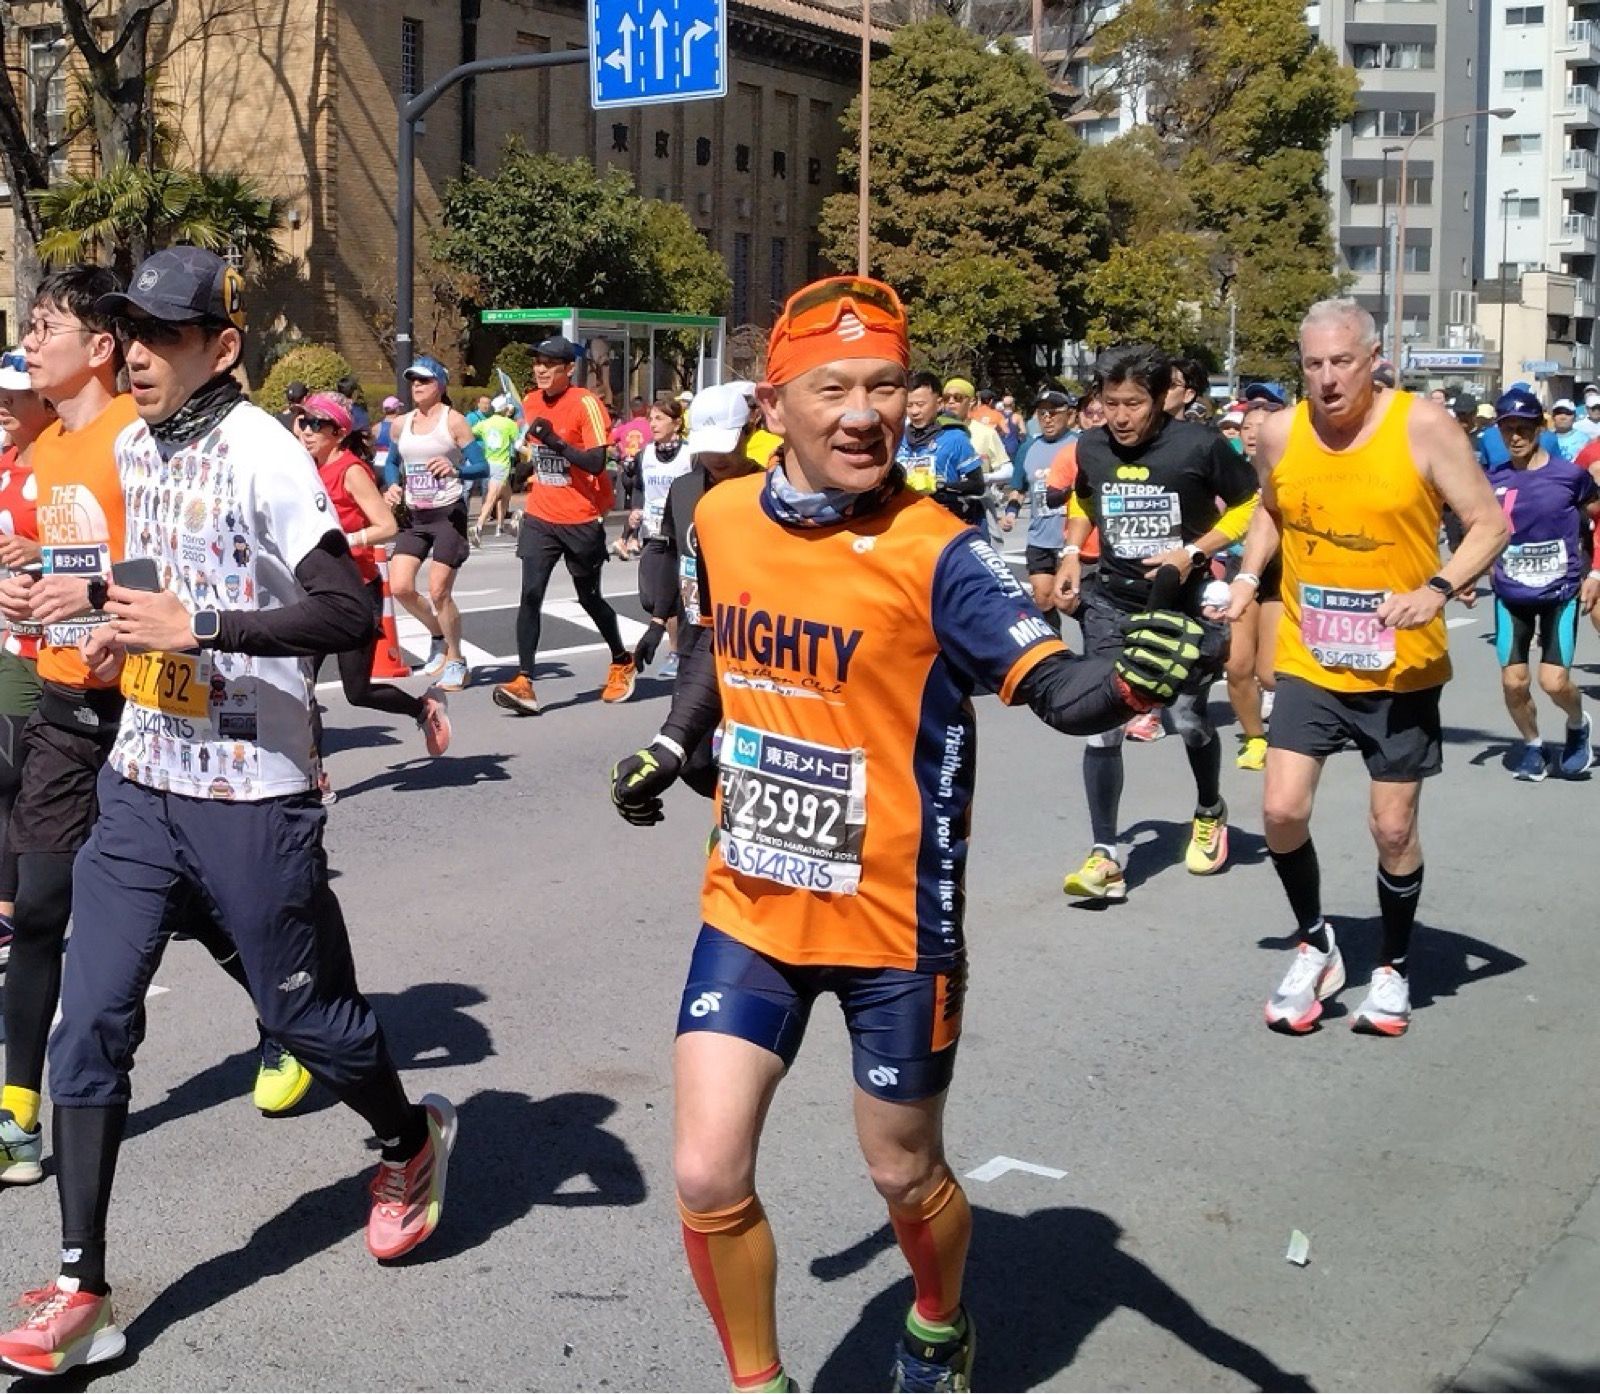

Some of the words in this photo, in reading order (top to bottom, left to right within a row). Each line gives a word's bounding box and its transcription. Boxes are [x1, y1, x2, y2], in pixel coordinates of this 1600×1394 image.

[51, 484, 77, 505] THE
[1101, 482, 1165, 496] CATERPY
[44, 523, 77, 544] FACE
[1119, 516, 1171, 537] 22359
[765, 745, 849, 780] 東京メトロ
[734, 778, 842, 846] 25992
[755, 833, 783, 848] TOKYO
[783, 840, 833, 860] MARATHON
[739, 845, 834, 889] STARTS
